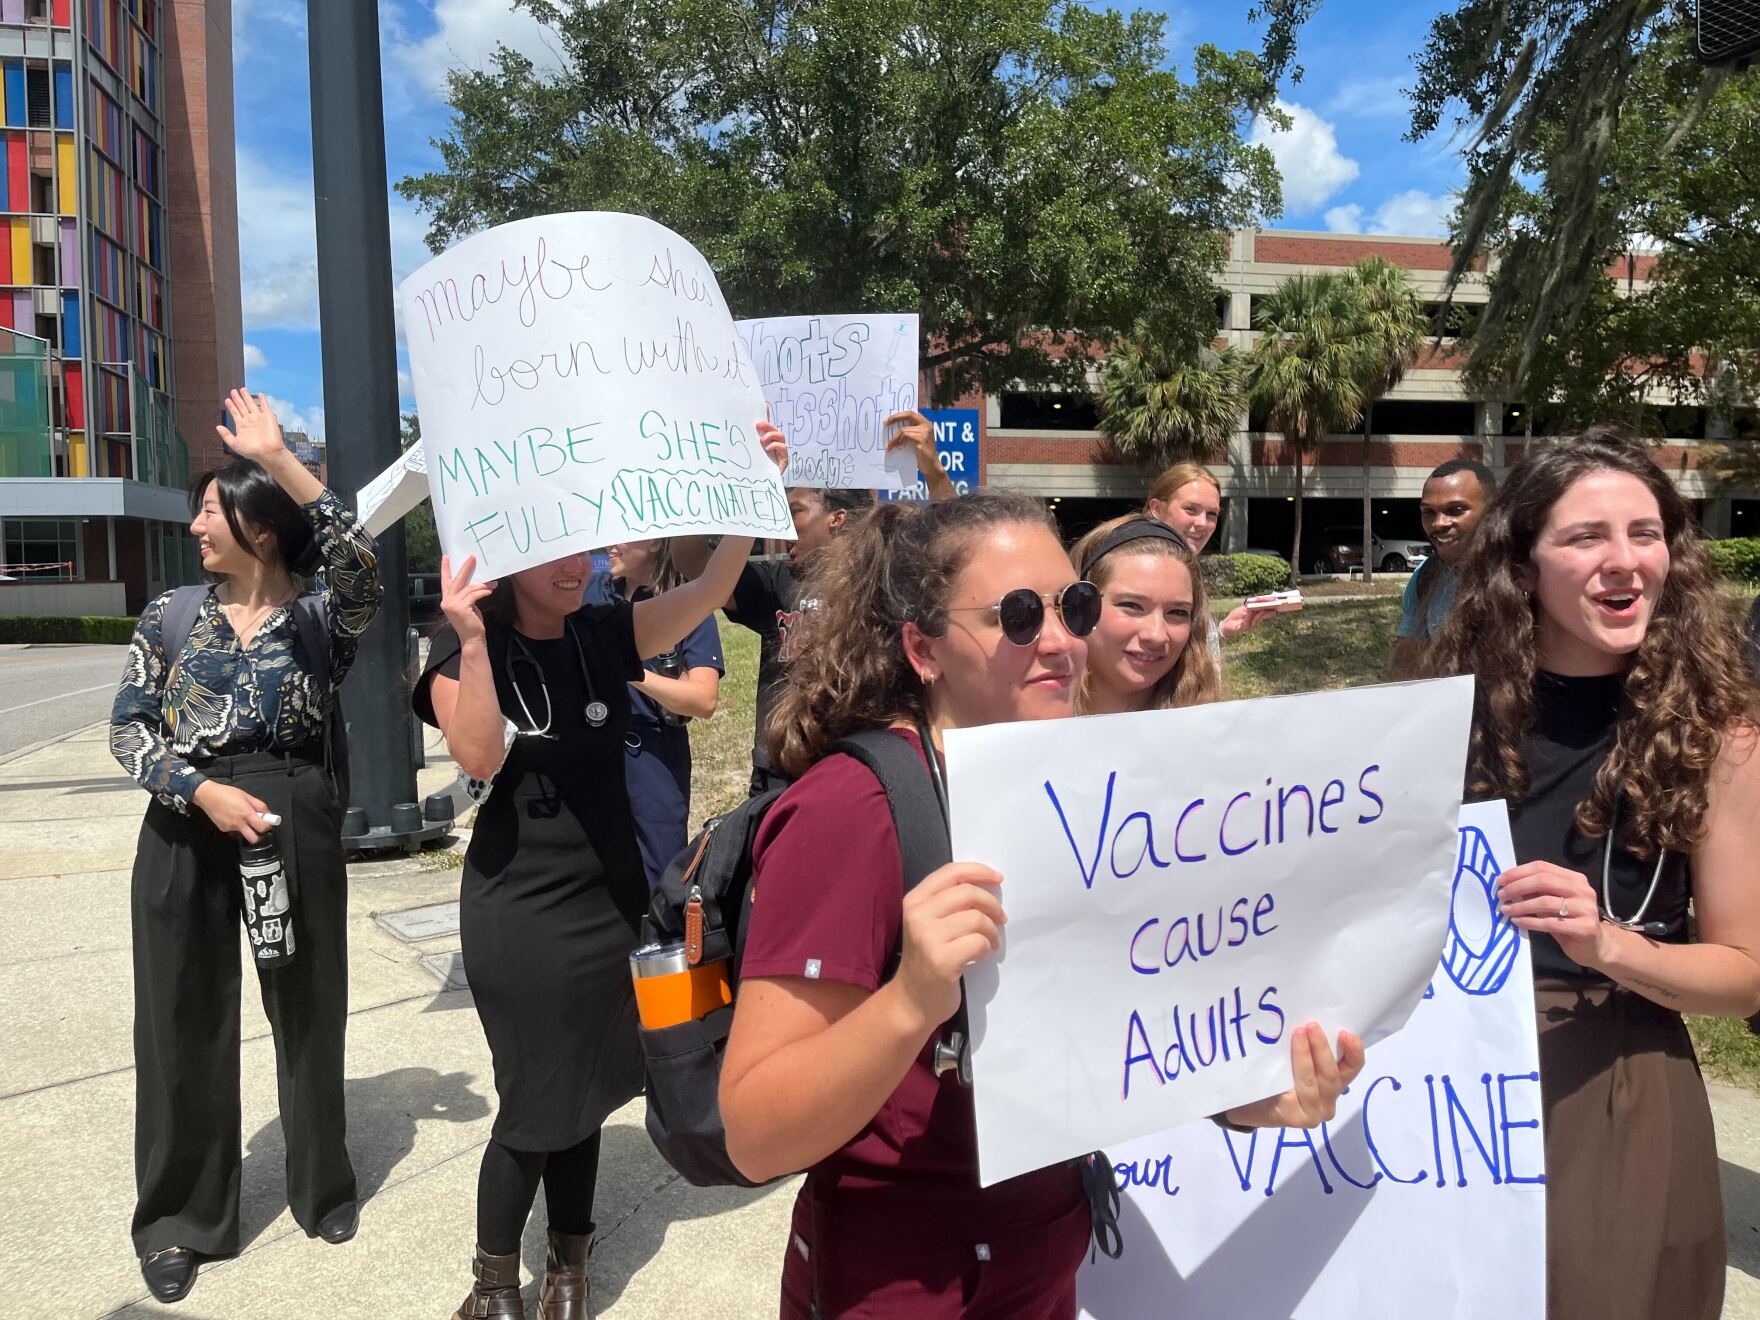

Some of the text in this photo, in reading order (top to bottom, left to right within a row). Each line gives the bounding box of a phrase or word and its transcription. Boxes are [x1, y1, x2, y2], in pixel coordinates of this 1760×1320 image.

[470, 341, 611, 410] born
[738, 318, 870, 386] hots
[438, 421, 607, 505] MAYBE
[639, 409, 753, 470] SHE'S
[961, 421, 975, 442] &
[463, 475, 789, 566] FULLY VACCINATED
[1043, 764, 1385, 889] Vaccines
[1129, 892, 1279, 975] cause
[1121, 986, 1285, 1102] Adults
